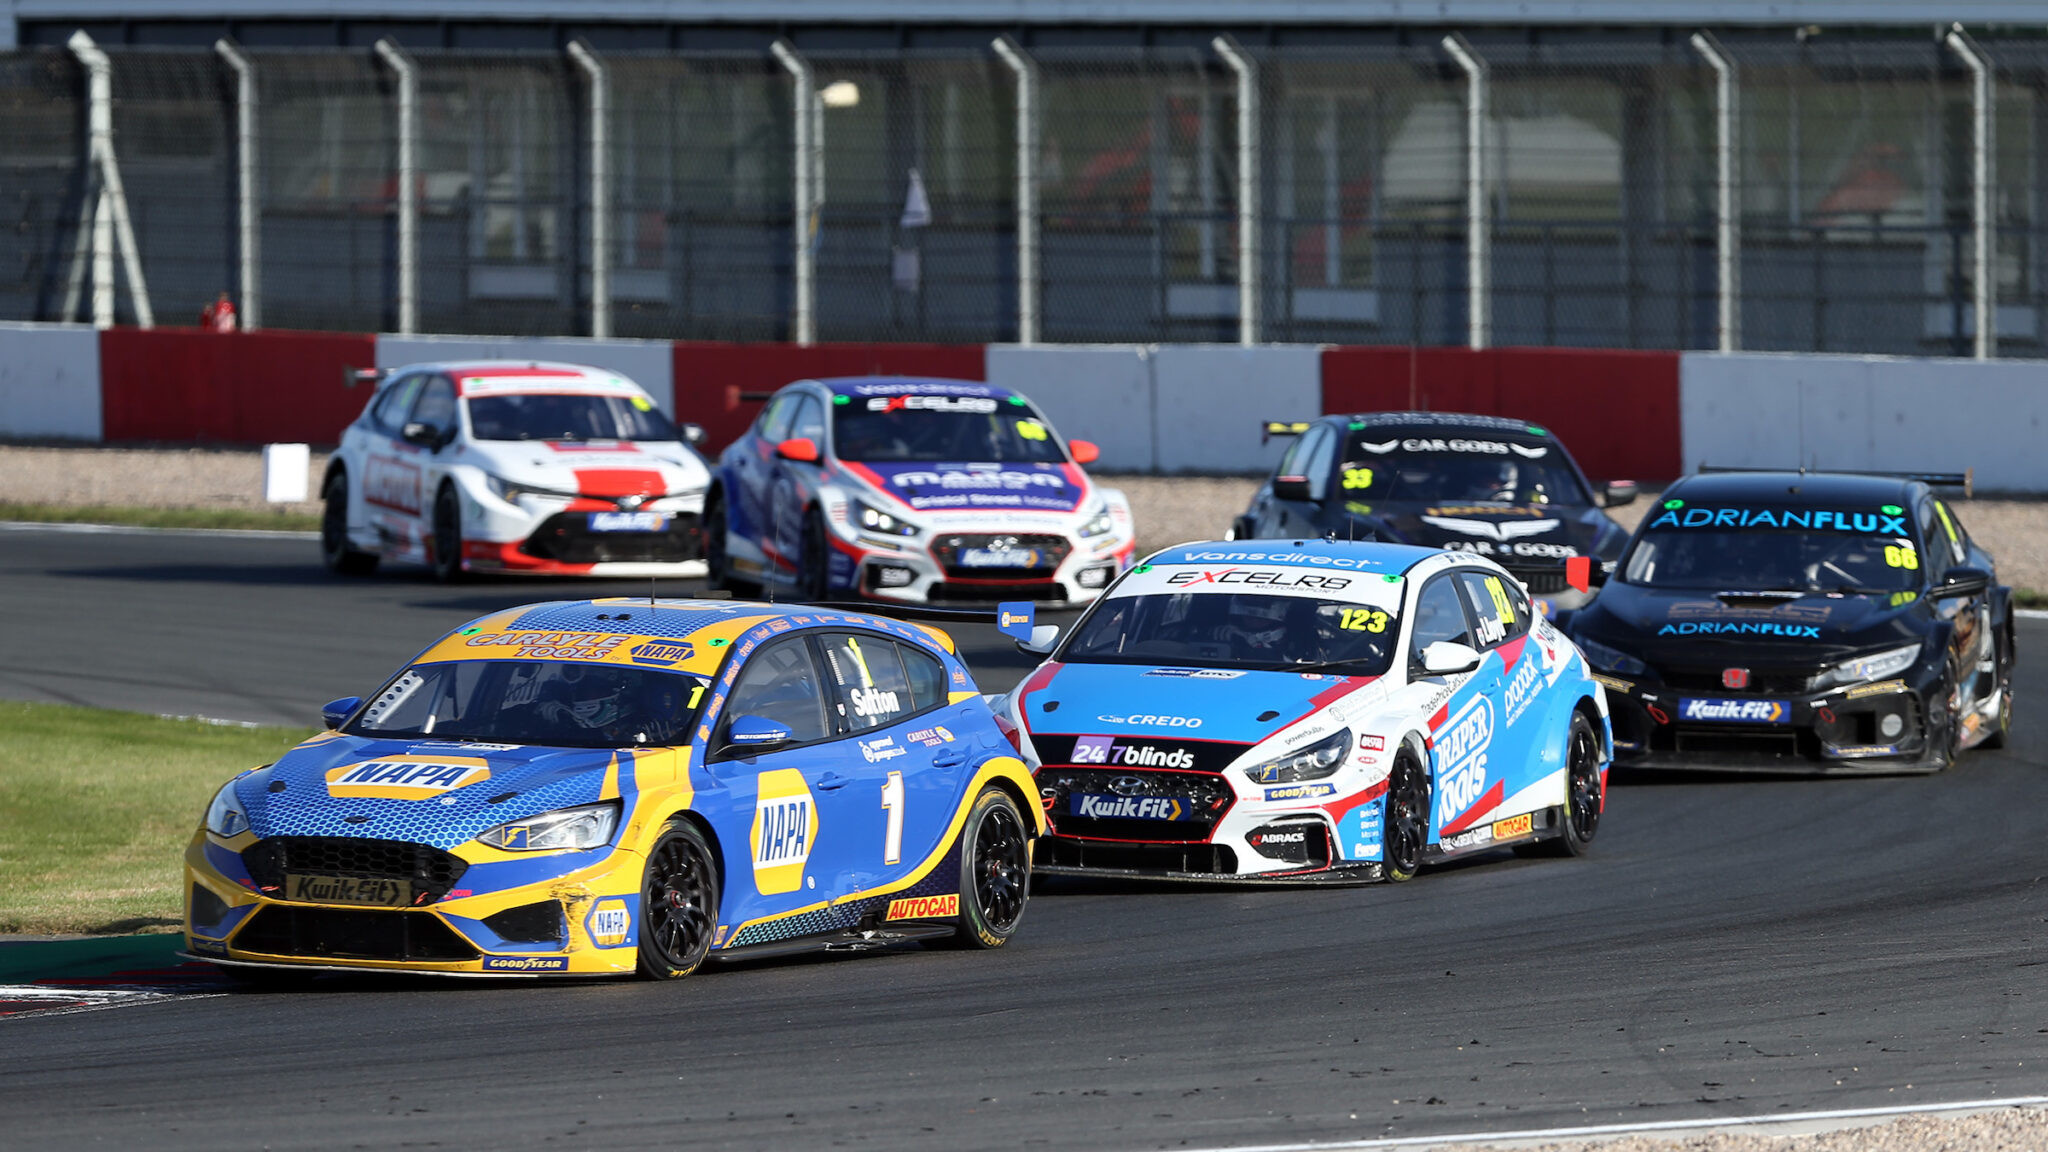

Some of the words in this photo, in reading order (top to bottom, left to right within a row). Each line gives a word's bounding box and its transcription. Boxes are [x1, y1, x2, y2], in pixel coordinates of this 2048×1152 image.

[1402, 439, 1448, 452] CAR
[1449, 439, 1509, 454] GODS
[1342, 468, 1373, 489] 33
[1650, 508, 1909, 537] ADRIANFLUX
[1443, 541, 1494, 555] CAR
[1513, 542, 1578, 558] GODS
[1884, 546, 1918, 570] 66
[1166, 567, 1352, 590] EXCELR8
[1254, 584, 1338, 595] MOTORSPORT
[1339, 608, 1388, 634] 123
[1657, 622, 1821, 639] ADRIANFLUX
[466, 633, 630, 649] CARLYLE
[636, 644, 685, 660] NAPA
[515, 646, 613, 660] TOOLS
[687, 687, 706, 709] 1
[850, 688, 901, 717] Sutton
[1126, 714, 1202, 728] CREDO
[1685, 699, 1773, 722] KwikFit
[1435, 705, 1489, 774] DRAPER
[344, 763, 471, 787] NAPA
[1270, 785, 1330, 799] GOODYEAR
[1079, 795, 1170, 819] KwikFit
[881, 771, 904, 866] 1
[759, 801, 808, 862] NAPA
[1260, 833, 1305, 844] ABRACS
[889, 895, 957, 920] AUTOCAR
[598, 911, 625, 934] NAPA
[489, 957, 563, 970] GOODYEAR
